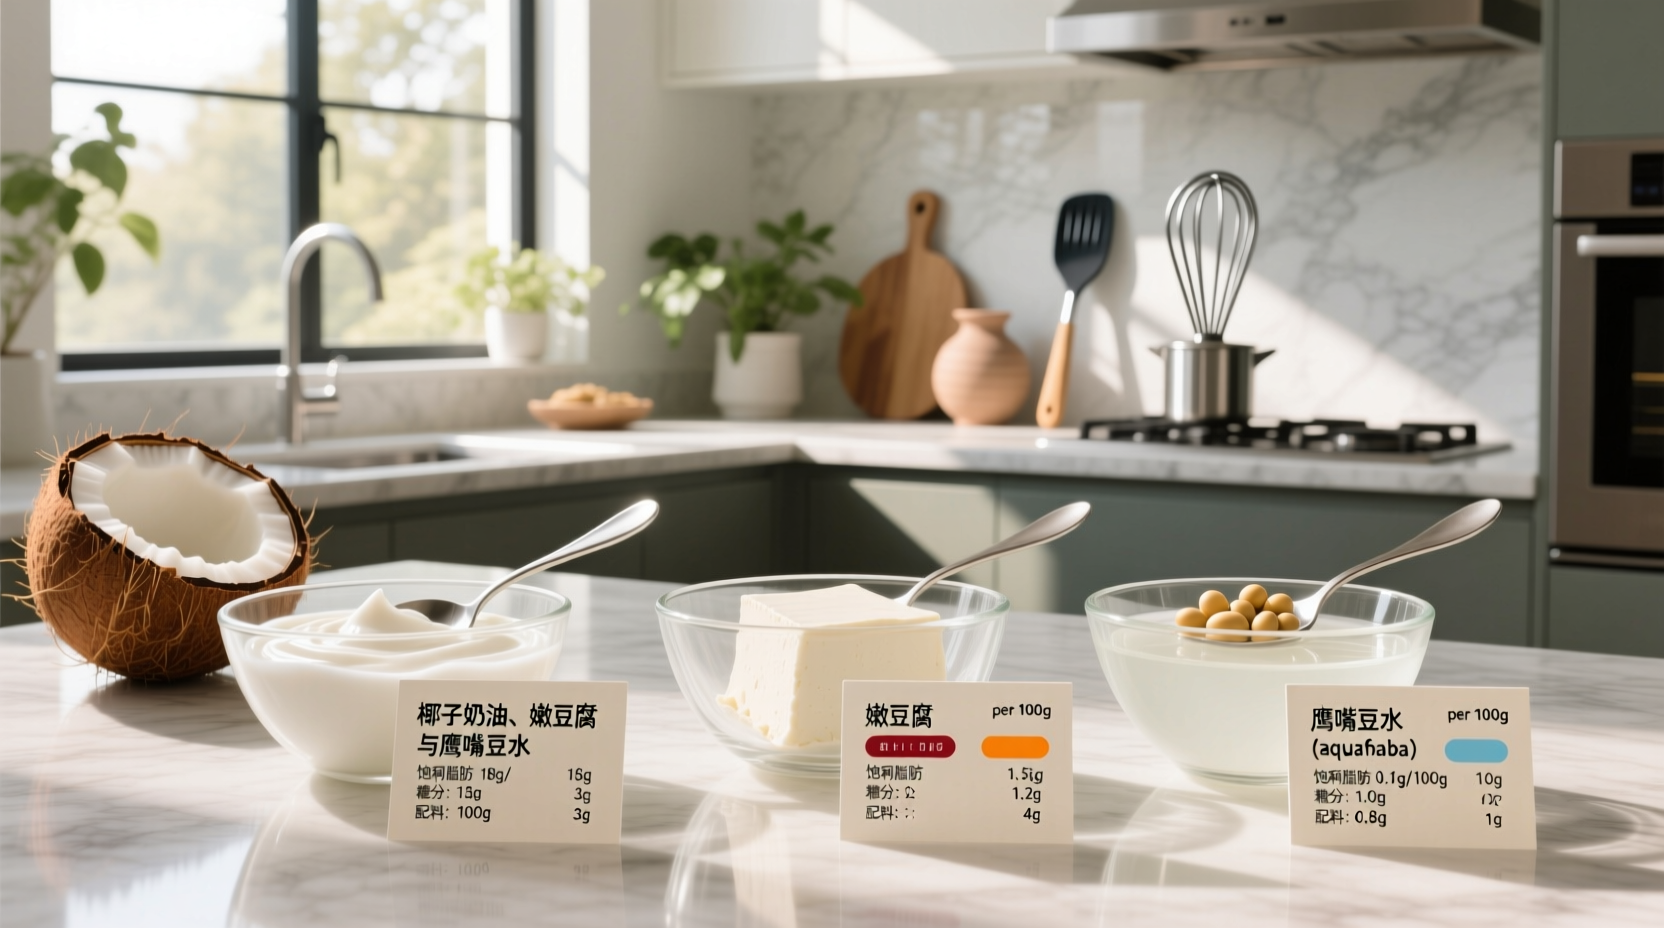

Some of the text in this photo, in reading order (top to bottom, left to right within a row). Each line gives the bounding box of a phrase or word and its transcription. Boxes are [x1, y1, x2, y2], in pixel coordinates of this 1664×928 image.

[416, 701, 599, 730] 椰子奶油、嫩豆腐
[864, 702, 934, 729] 嫩豆腐
[992, 703, 1052, 720] per 100g
[1447, 707, 1509, 725] per 100g
[1375, 769, 1448, 790] 0.1g/100g
[1475, 771, 1503, 789] 10g
[573, 787, 592, 805] 3g
[1012, 786, 1042, 804] 1.2g
[1355, 789, 1386, 807] 1.0g
[457, 805, 492, 823] 100g
[572, 807, 591, 825] 3g
[1022, 807, 1041, 825] 4g
[1485, 812, 1503, 829] 1g
